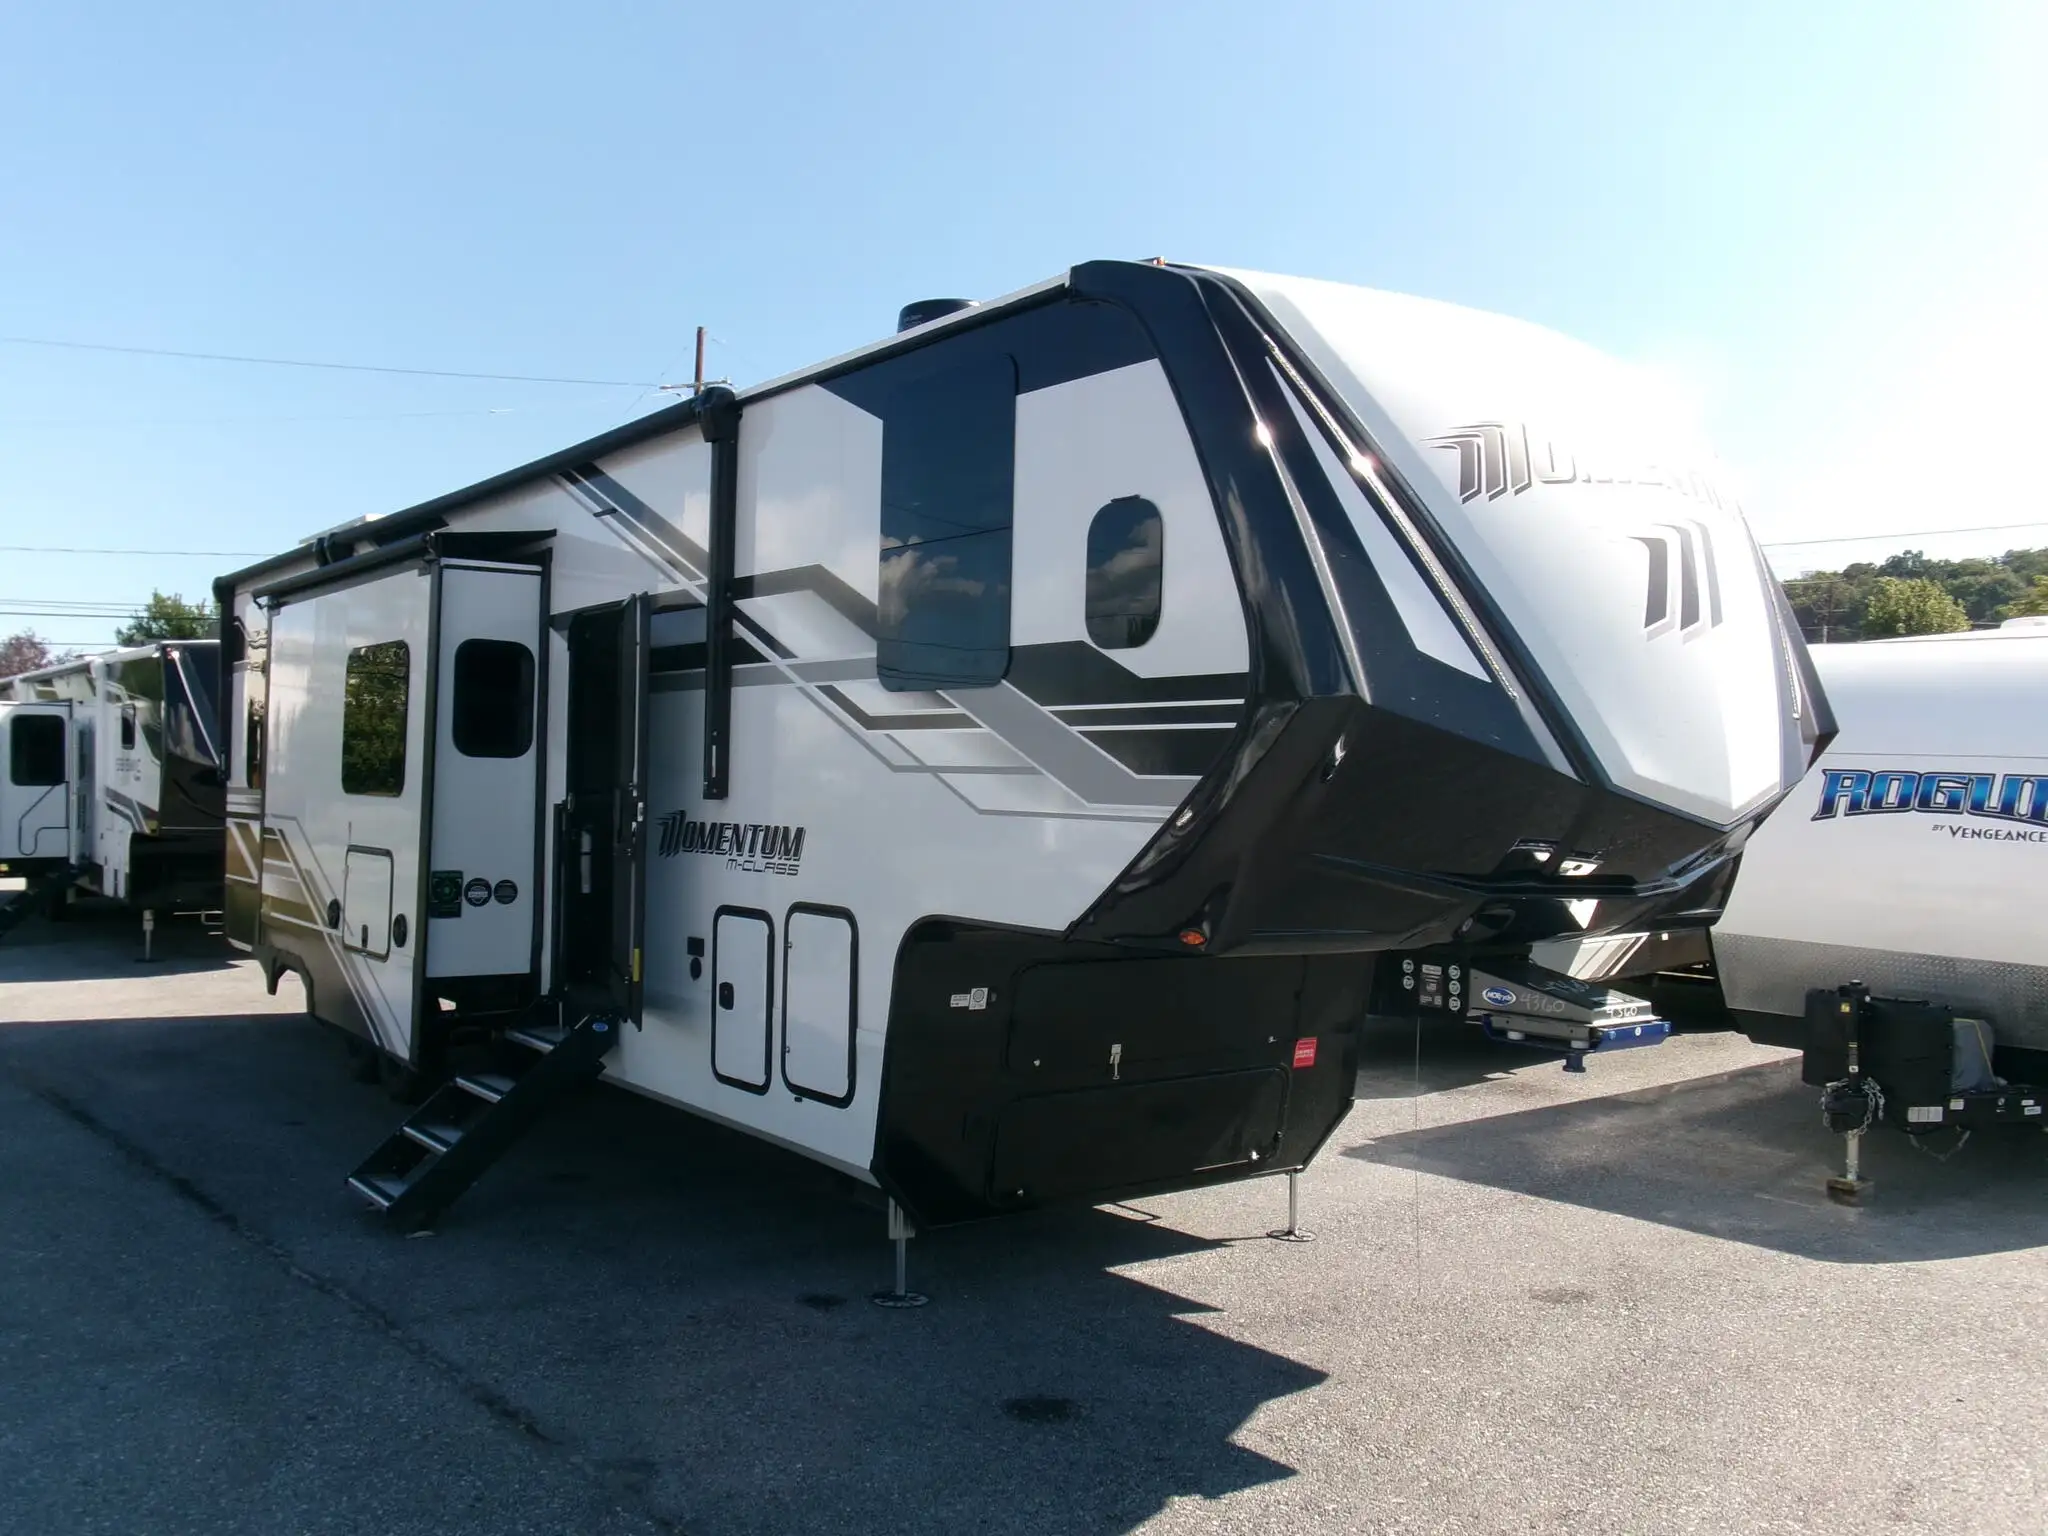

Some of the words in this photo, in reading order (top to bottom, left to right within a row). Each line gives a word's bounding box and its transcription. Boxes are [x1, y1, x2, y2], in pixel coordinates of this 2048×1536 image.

[656, 809, 806, 861] MOMENTUM
[1931, 824, 1946, 832] BY
[1949, 825, 2048, 843] VENGEANCE
[1520, 991, 1565, 1012] 4360
